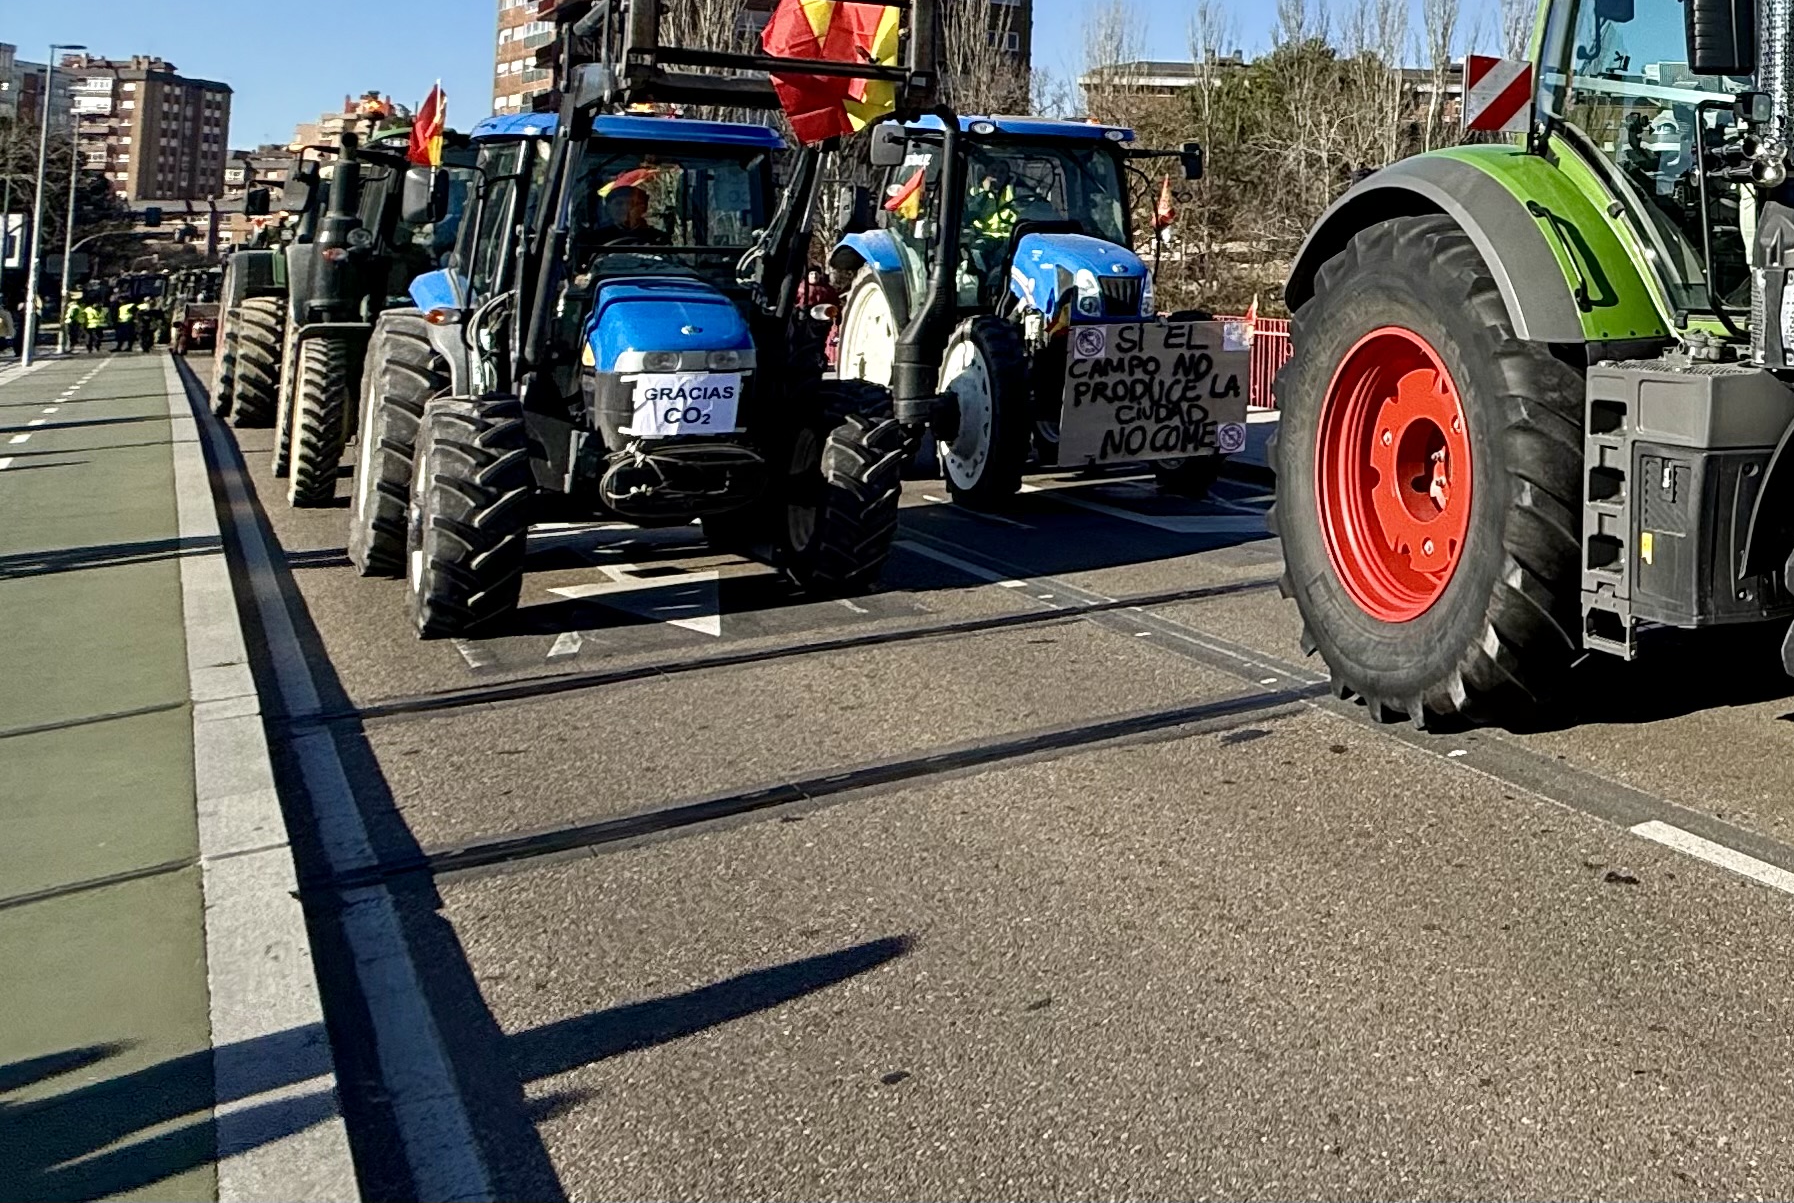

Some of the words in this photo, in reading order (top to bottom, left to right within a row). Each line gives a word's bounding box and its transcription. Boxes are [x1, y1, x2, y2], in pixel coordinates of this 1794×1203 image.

[1115, 323, 1145, 353] SI
[1163, 324, 1209, 350] EL
[1068, 355, 1161, 380] CAMPO
[1173, 353, 1213, 380] NO
[644, 385, 734, 401] GRACIAS
[1073, 375, 1202, 409] PRODUCE
[1209, 373, 1241, 398] LA
[1100, 424, 1147, 460] NO
[1149, 420, 1218, 453] COME
